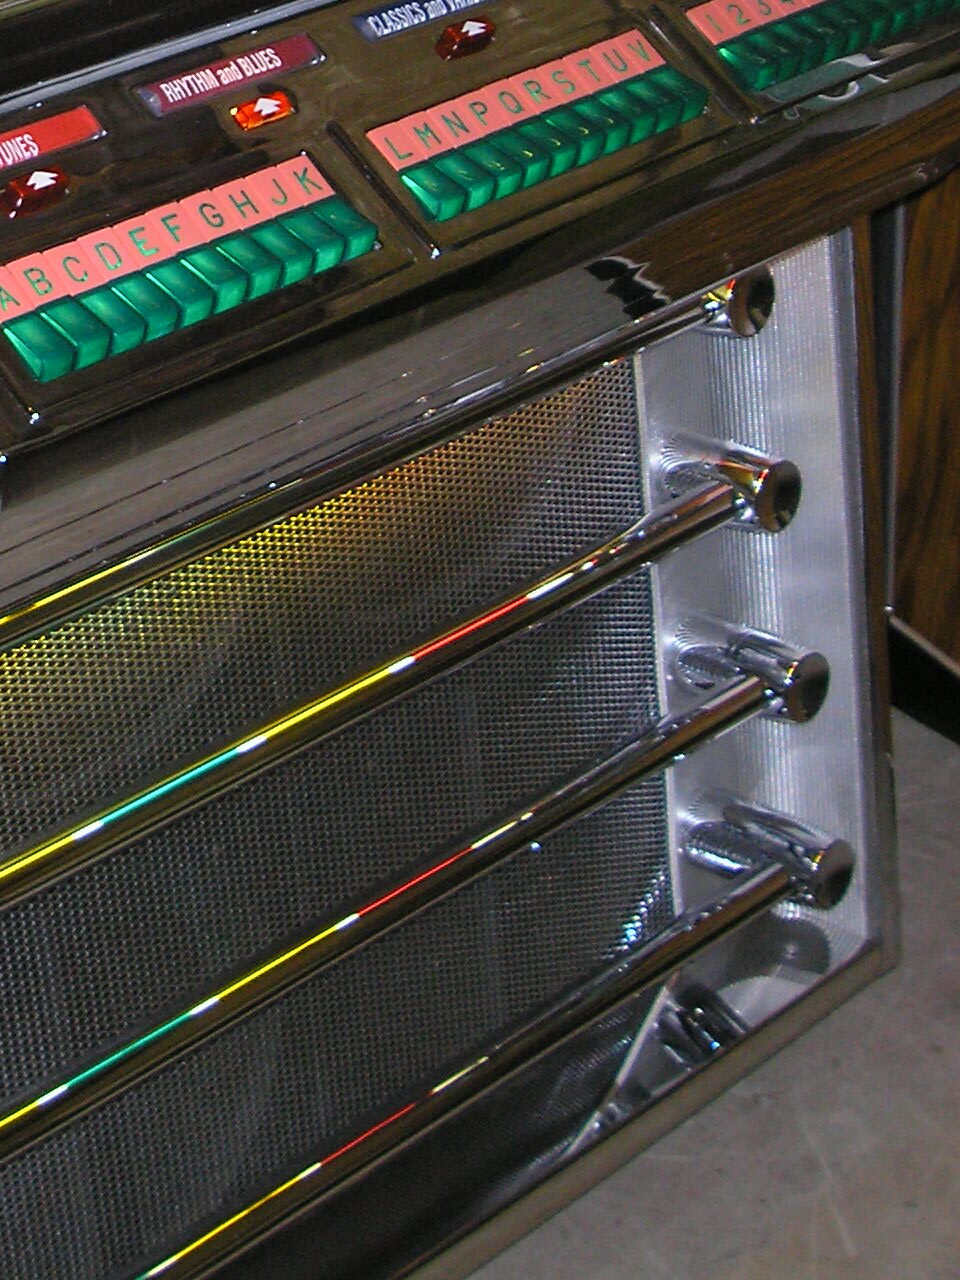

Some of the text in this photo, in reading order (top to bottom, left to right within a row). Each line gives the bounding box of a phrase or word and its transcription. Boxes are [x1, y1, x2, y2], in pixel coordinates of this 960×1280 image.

[367, 1, 426, 37] CLASSICS
[726, 4, 750, 25] 2
[160, 48, 283, 103] RHYTHM and BLUES
[383, 39, 652, 161] L M N P Q R S T U V
[24, 267, 54, 297] B
[61, 256, 90, 284] C
[95, 241, 123, 272] D
[127, 226, 160, 258] E
[161, 213, 186, 243] F
[197, 202, 225, 228] G
[228, 189, 261, 219] H
[269, 178, 290, 205] J
[293, 167, 324, 195] K
